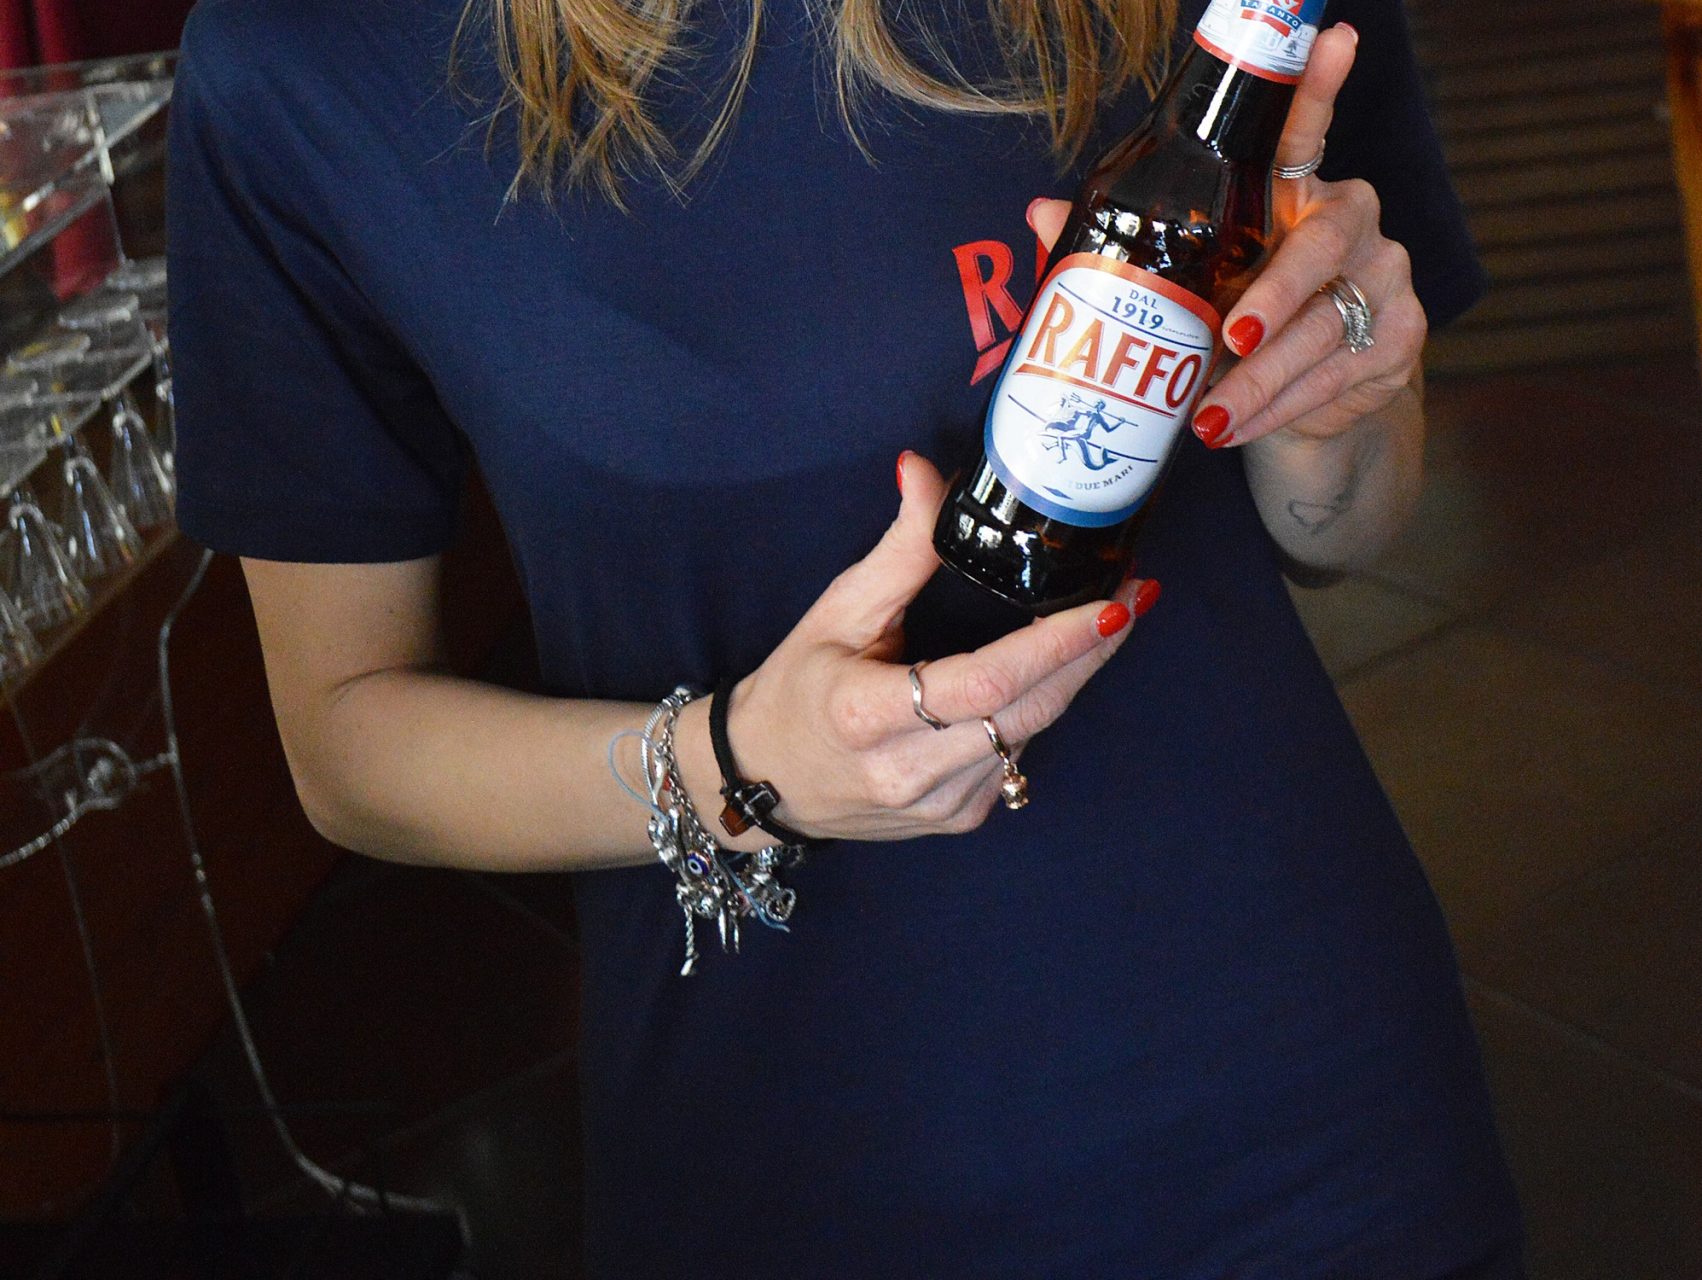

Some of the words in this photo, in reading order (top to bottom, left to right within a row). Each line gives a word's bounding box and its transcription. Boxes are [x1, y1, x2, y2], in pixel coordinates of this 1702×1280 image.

[1112, 296, 1164, 329] 1919
[1129, 289, 1158, 309] DAL
[1027, 291, 1202, 410] RAFFO
[1075, 481, 1101, 490] DUE
[1103, 465, 1134, 487] MARI
